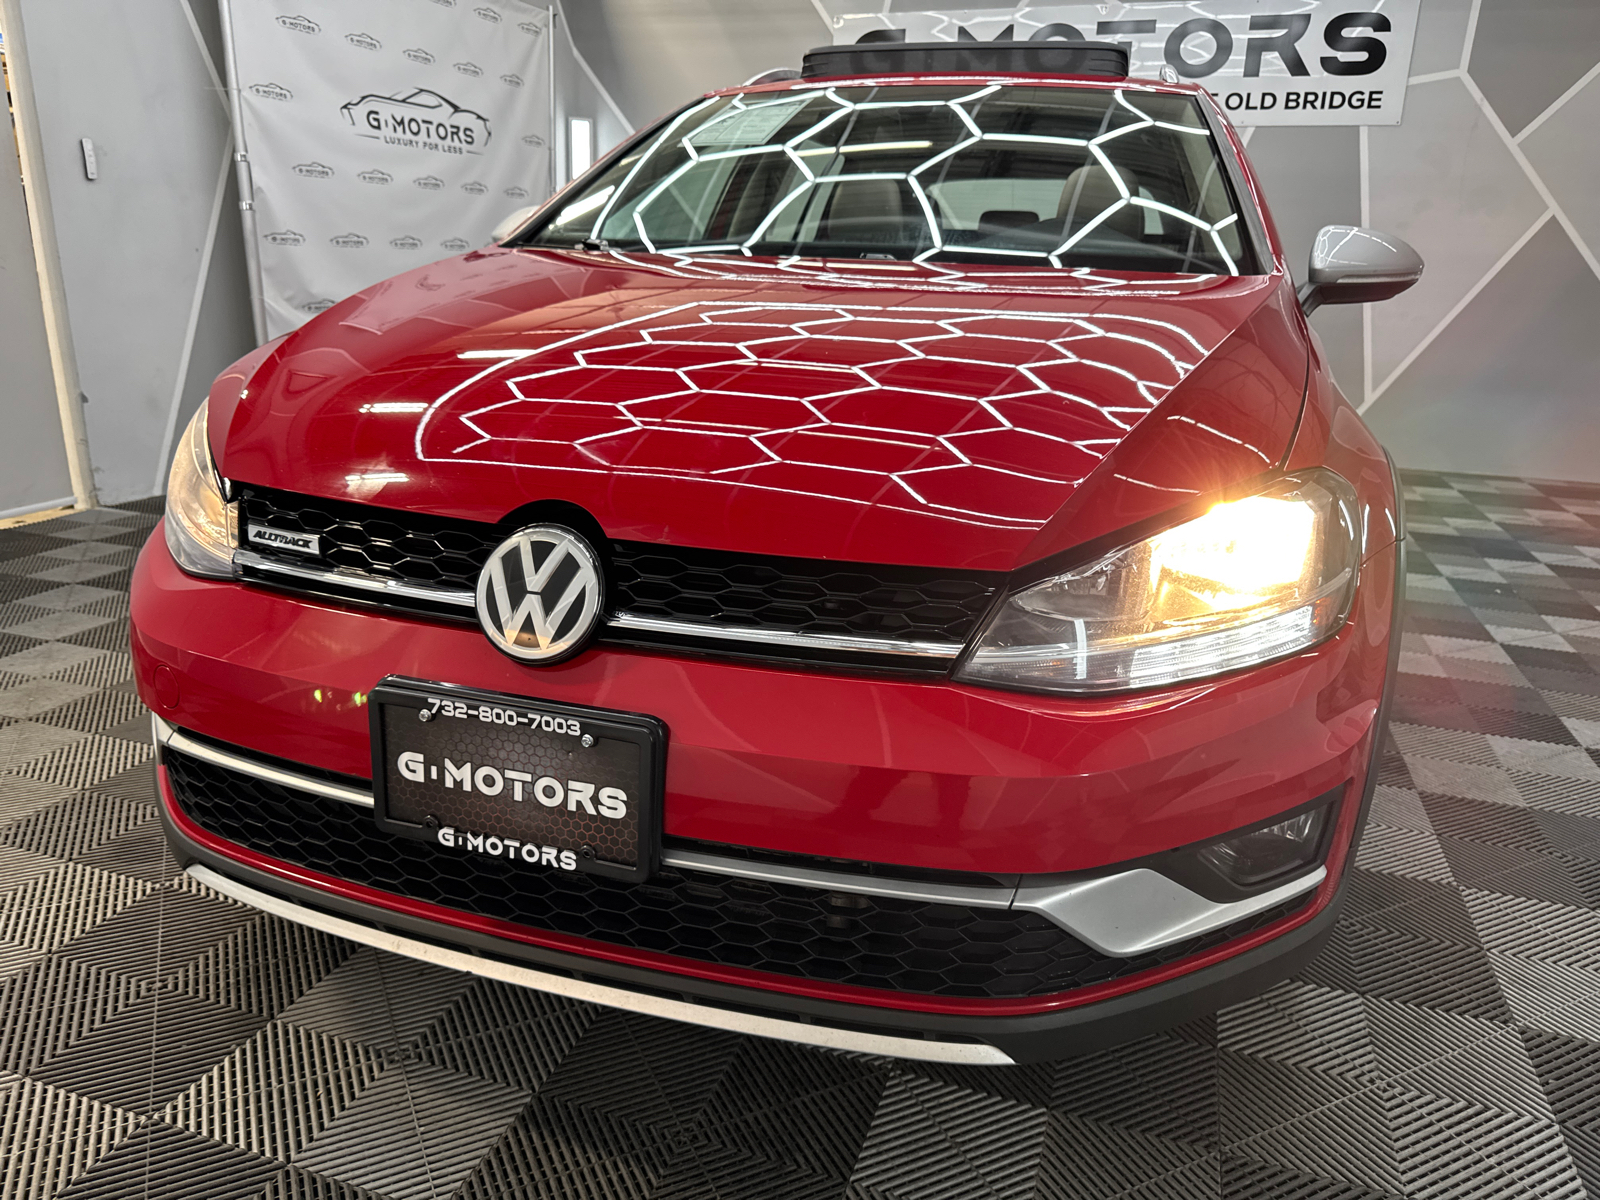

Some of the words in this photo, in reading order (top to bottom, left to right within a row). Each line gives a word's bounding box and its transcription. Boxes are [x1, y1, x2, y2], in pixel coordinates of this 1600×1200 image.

[1225, 92, 1277, 111] OLD
[1284, 90, 1383, 110] BRIDGE
[384, 135, 419, 148] LUXURY
[422, 141, 440, 151] FOR
[442, 144, 463, 155] LESS
[253, 530, 313, 549] ALLTRACK
[427, 697, 582, 737] 732-800-7003
